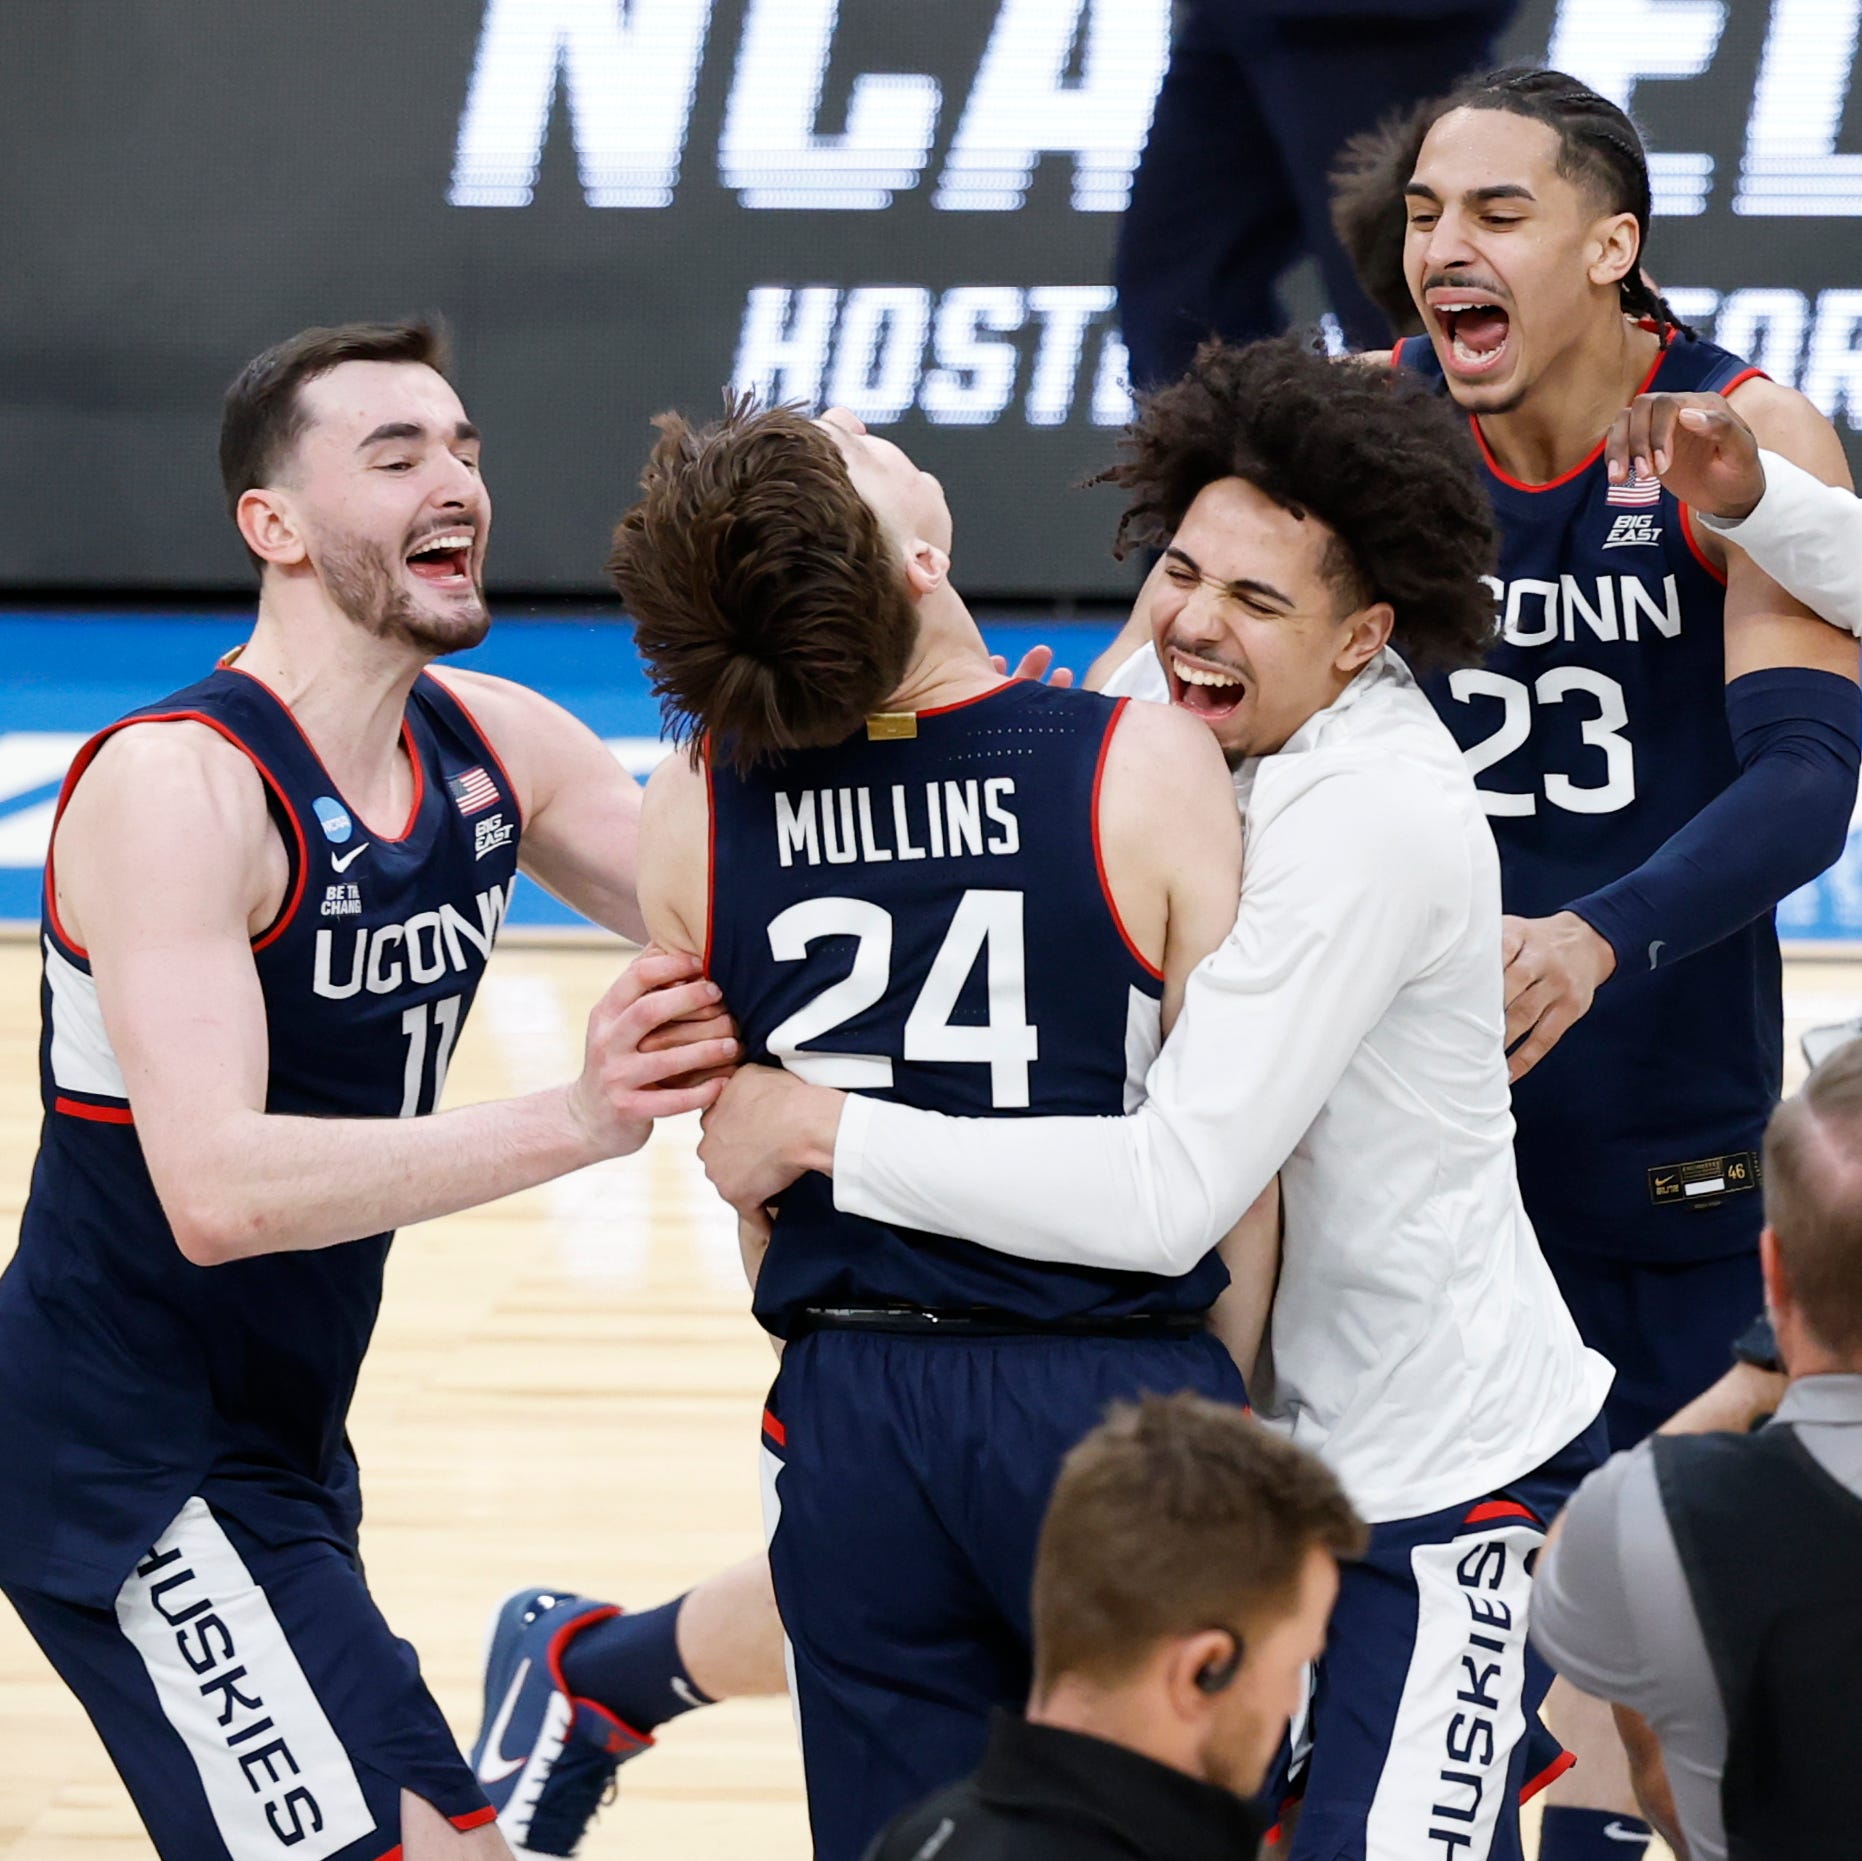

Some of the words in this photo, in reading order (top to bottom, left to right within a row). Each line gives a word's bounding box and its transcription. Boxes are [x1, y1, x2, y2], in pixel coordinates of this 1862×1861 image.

[1606, 528, 1663, 542] EAST
[1612, 514, 1654, 529] BIG
[1448, 666, 1635, 816] 23
[475, 813, 503, 837] BIG
[774, 777, 1020, 867] MULLINS
[474, 823, 514, 852] EAST
[326, 885, 345, 901] BE
[766, 889, 1038, 1108] 24
[399, 994, 461, 1118] 11
[1727, 1163, 1746, 1180] 46
[137, 1546, 324, 1847] HUSKIES
